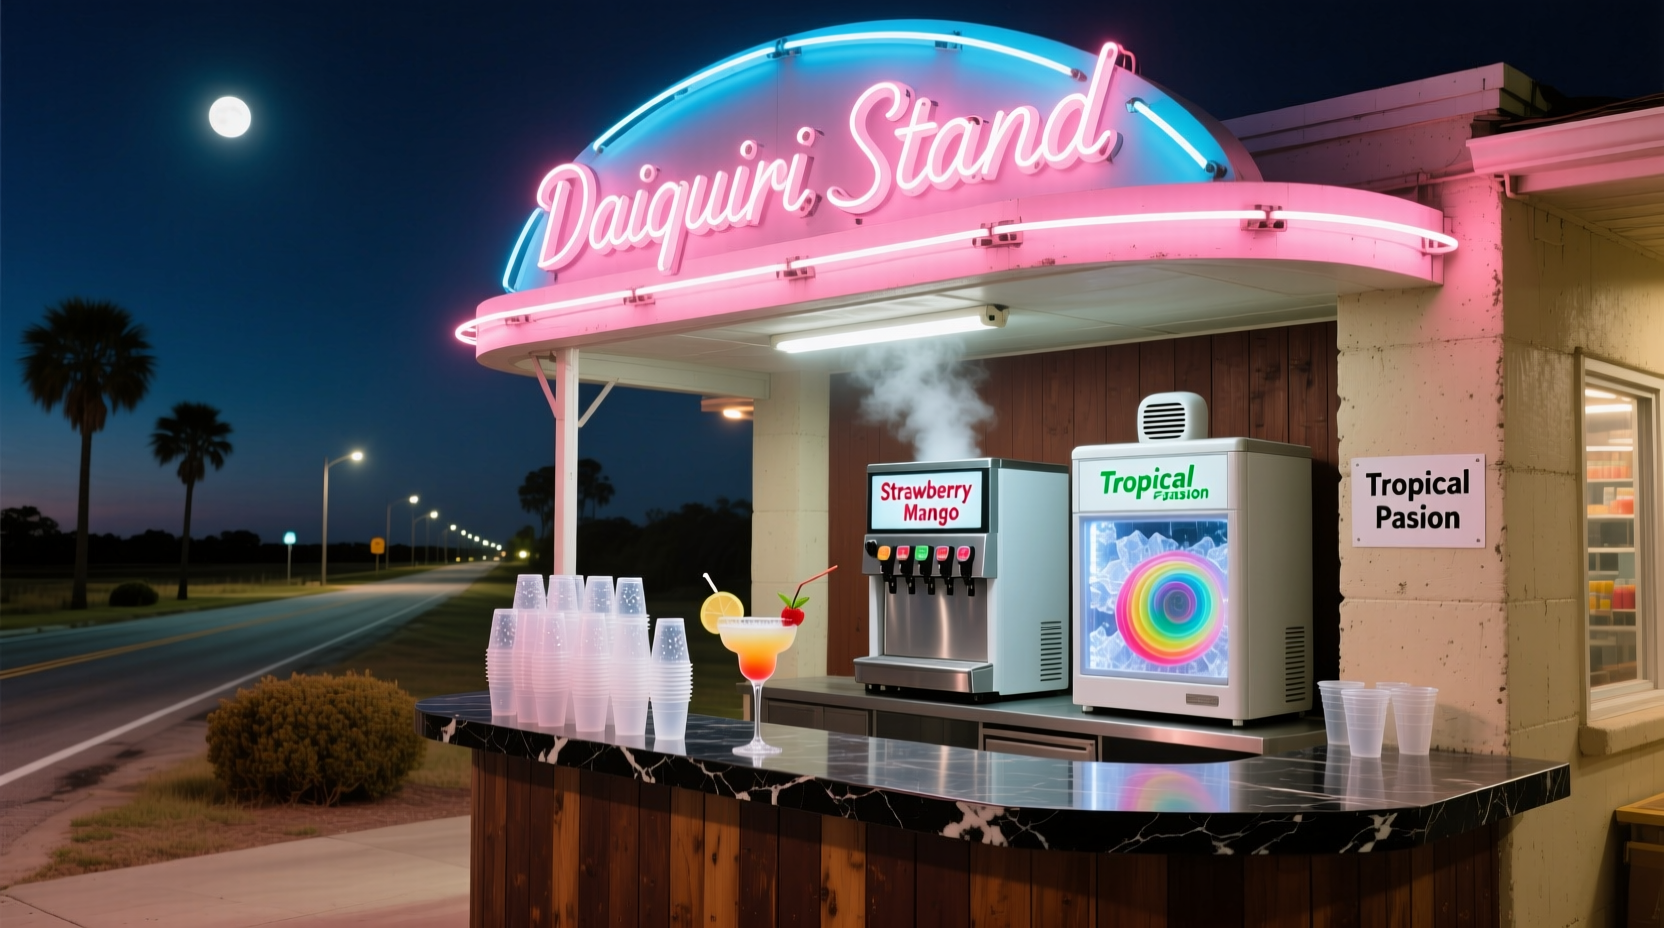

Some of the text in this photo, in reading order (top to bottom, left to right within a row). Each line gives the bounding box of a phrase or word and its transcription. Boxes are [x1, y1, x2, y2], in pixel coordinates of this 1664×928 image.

[537, 42, 1122, 273] Daiquiri Stand
[880, 479, 972, 504] Strawberry
[1100, 464, 1195, 500] Tropical
[1365, 468, 1470, 502] Tropical
[903, 503, 959, 526] Mango
[1376, 504, 1460, 529] Pasion
